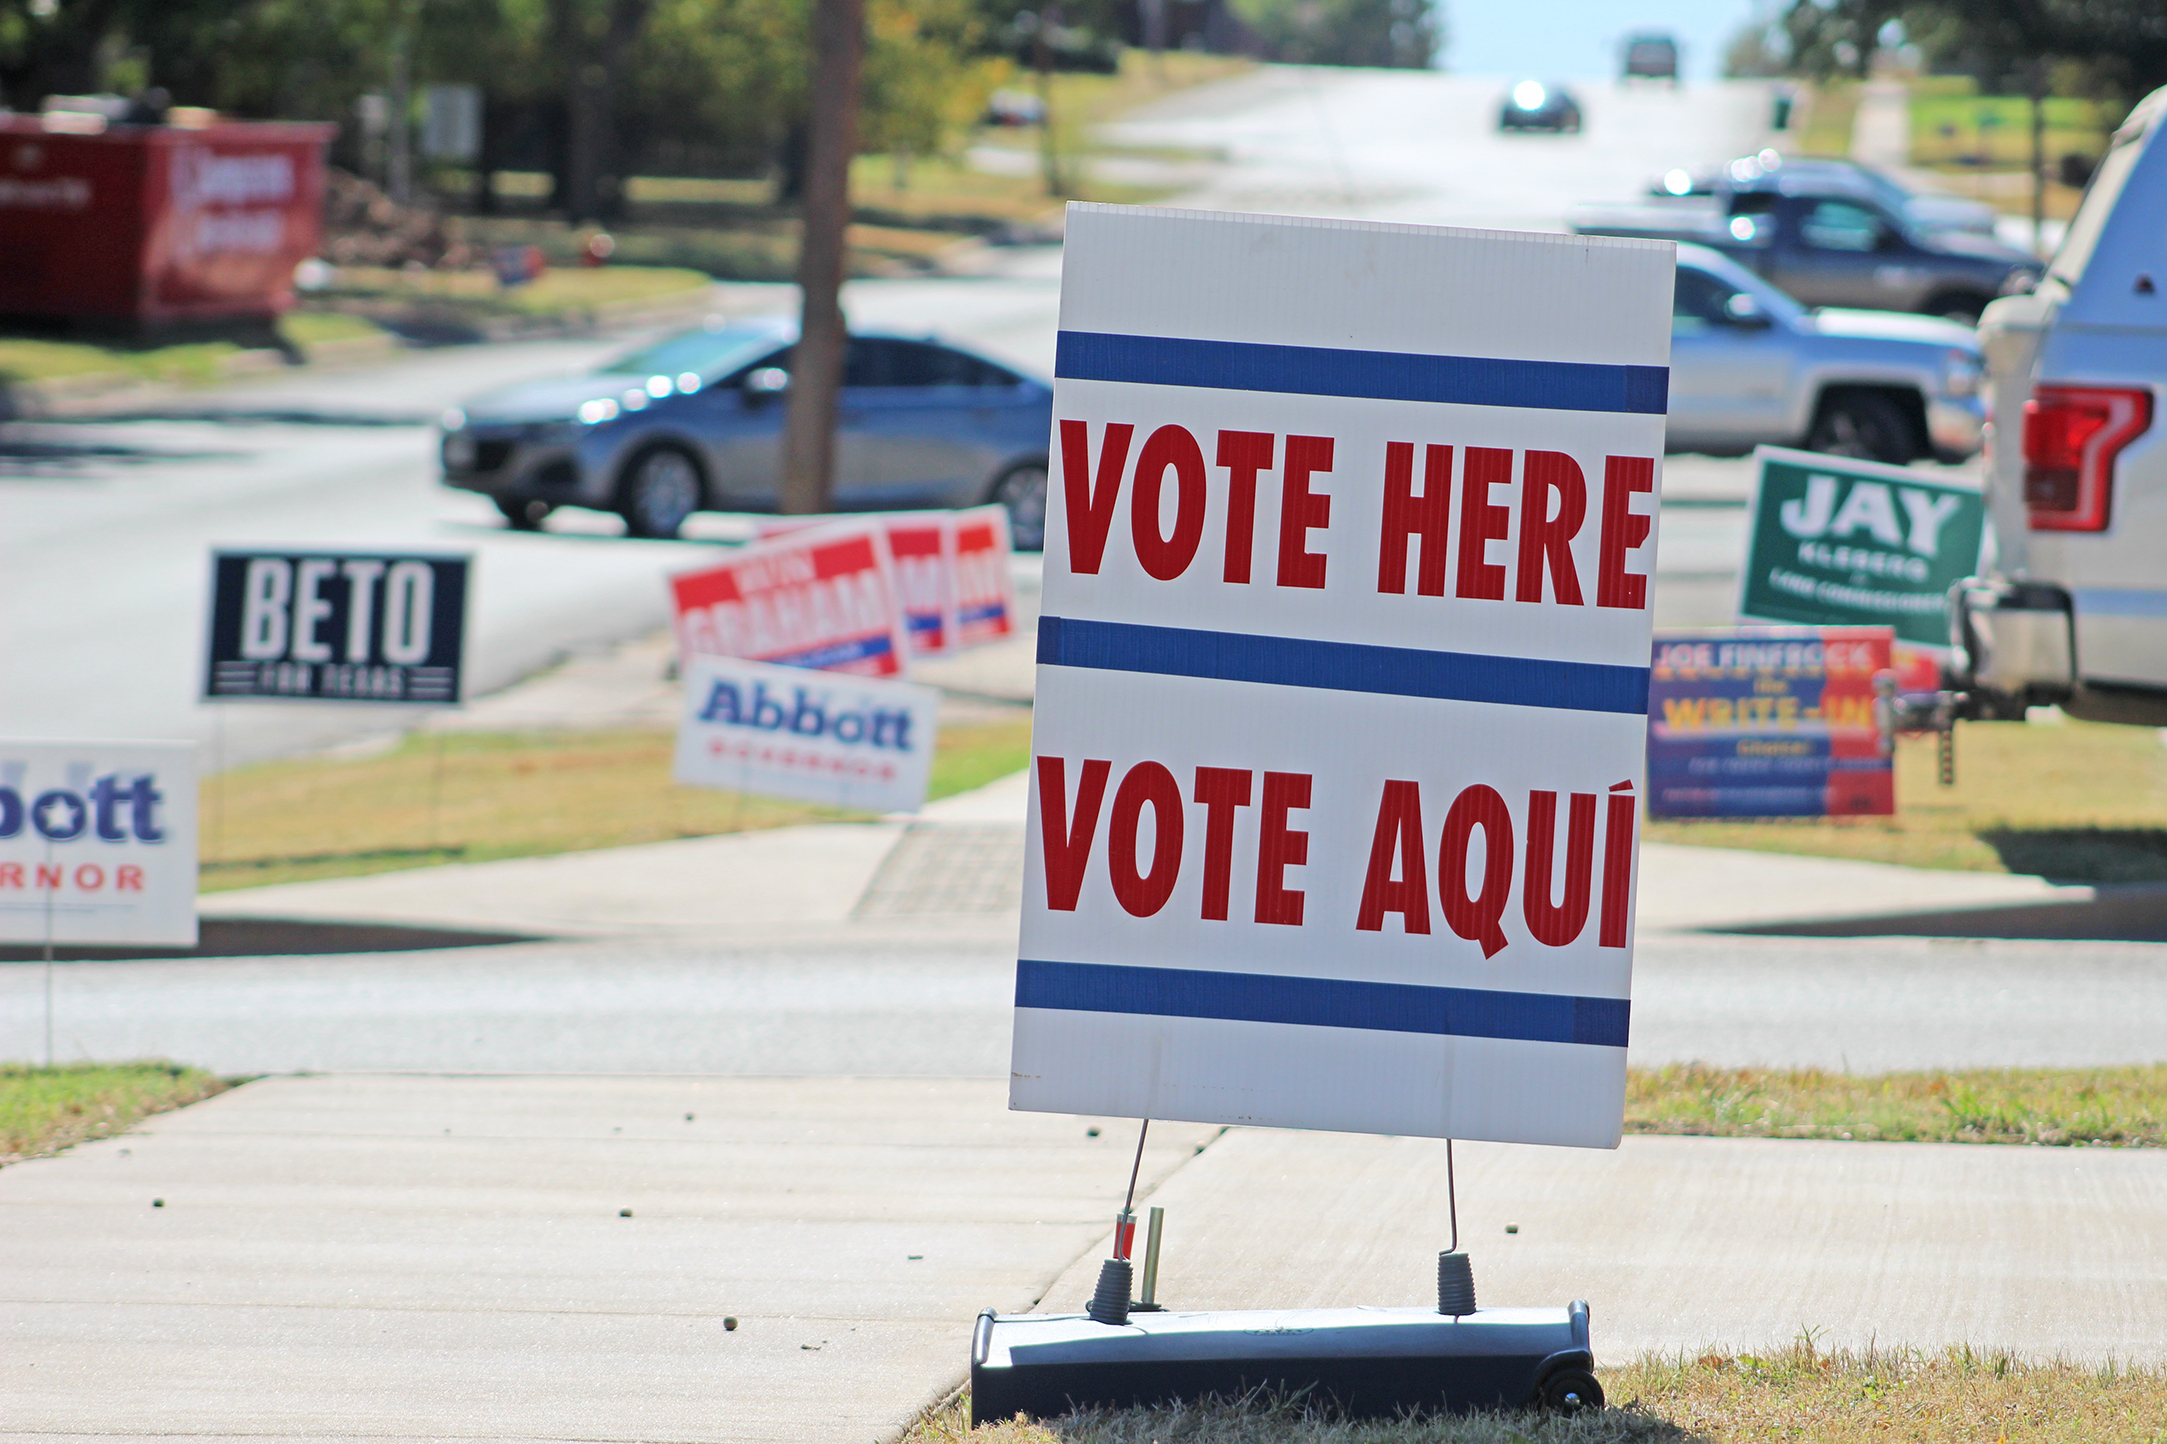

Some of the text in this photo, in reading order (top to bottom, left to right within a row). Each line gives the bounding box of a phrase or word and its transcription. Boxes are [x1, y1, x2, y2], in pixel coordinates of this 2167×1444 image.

[1059, 419, 1335, 589] VOTE
[1377, 441, 1655, 610] HERE
[1779, 474, 1960, 559] JAY
[1798, 541, 1929, 584] KLEBERG
[240, 557, 435, 666] BETO
[1653, 642, 1714, 670] JOE
[697, 678, 914, 753] Abbott
[1662, 697, 1875, 732] WRITE-IN
[1037, 755, 1636, 960] VOTE AQUÍ
